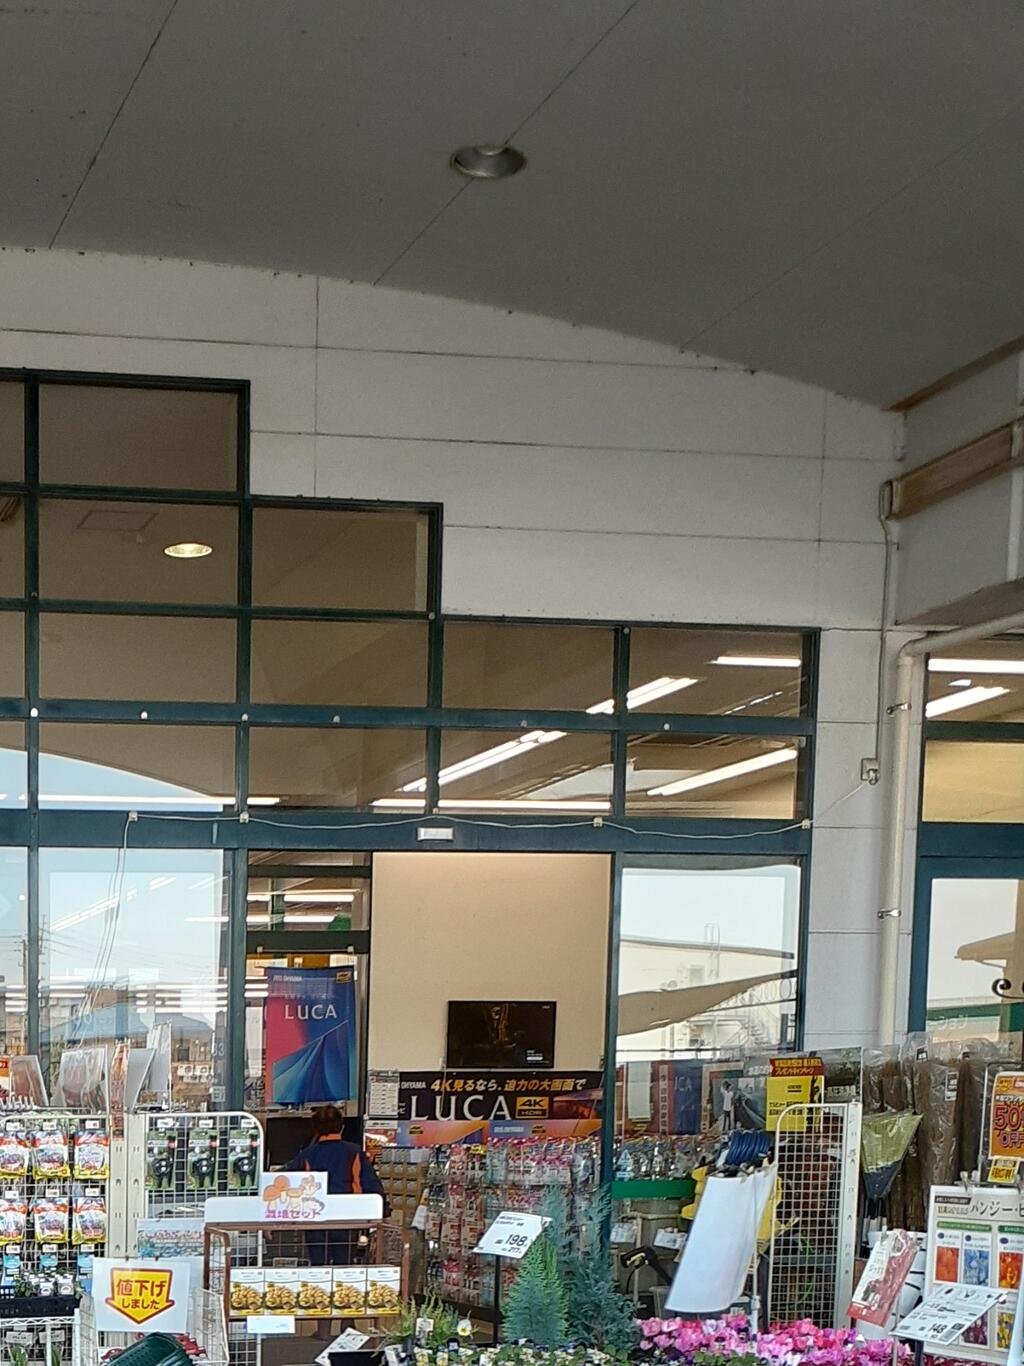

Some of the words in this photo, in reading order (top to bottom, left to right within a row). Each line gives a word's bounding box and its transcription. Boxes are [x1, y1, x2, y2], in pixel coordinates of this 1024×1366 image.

[284, 1003, 338, 1020] LUCA
[410, 1095, 512, 1121] LUCA
[519, 1098, 545, 1108] 4K
[505, 1234, 528, 1247] 198
[116, 1279, 167, 1297] 値下げ
[122, 1298, 160, 1310] しました
